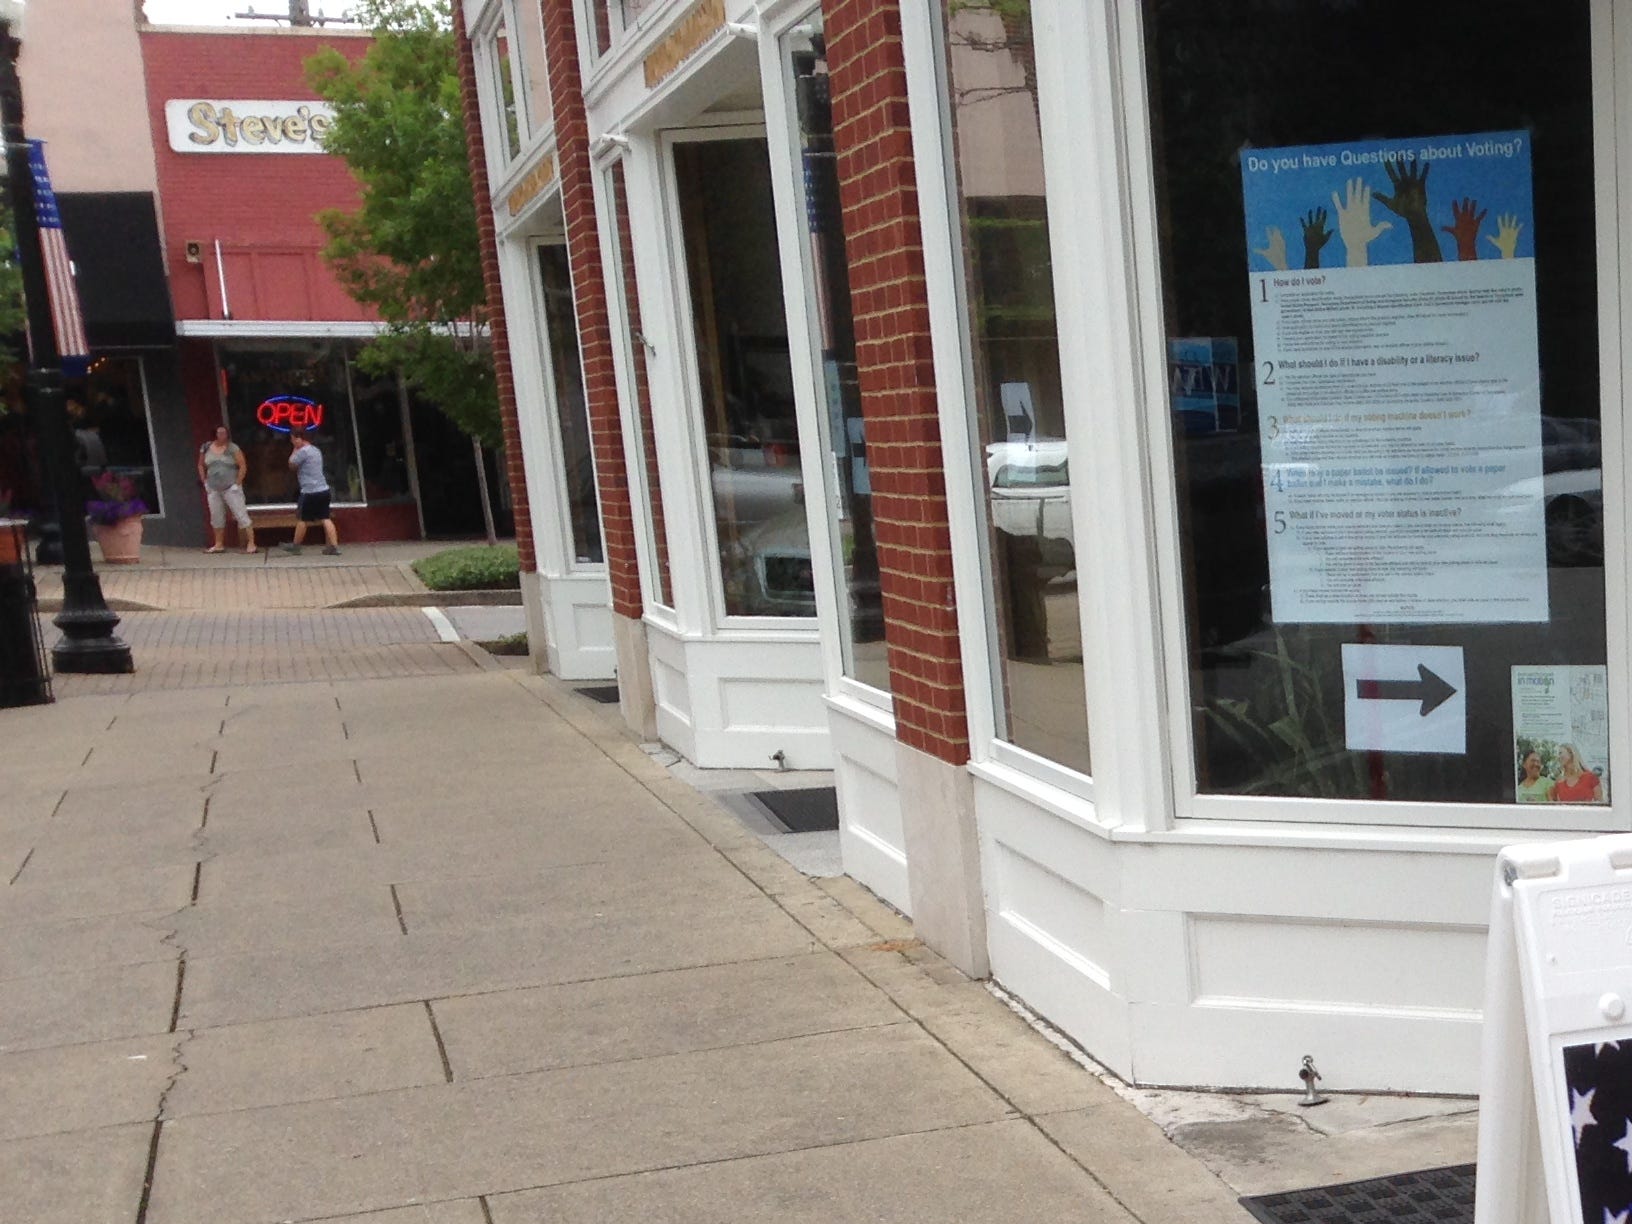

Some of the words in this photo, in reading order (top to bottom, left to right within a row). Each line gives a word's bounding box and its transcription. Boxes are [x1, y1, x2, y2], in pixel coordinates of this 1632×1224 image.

[187, 102, 329, 147] Steve's
[1248, 156, 1268, 172] Do
[1272, 158, 1299, 174] you
[1303, 152, 1337, 169] have
[1340, 148, 1416, 167] Questions
[1419, 143, 1463, 161] about
[1466, 138, 1523, 159] Voting?
[1274, 278, 1289, 287] How
[1291, 277, 1300, 286] do
[1306, 275, 1326, 285] vote?
[1279, 358, 1297, 369] What
[1351, 356, 1369, 366] have
[1376, 354, 1408, 367] disability
[1425, 353, 1453, 365] literacy
[1455, 351, 1480, 363] issue?
[1262, 361, 1276, 385] 2
[257, 402, 324, 427] OPEN
[1267, 415, 1280, 440] 3
[1274, 511, 1287, 535] 5
